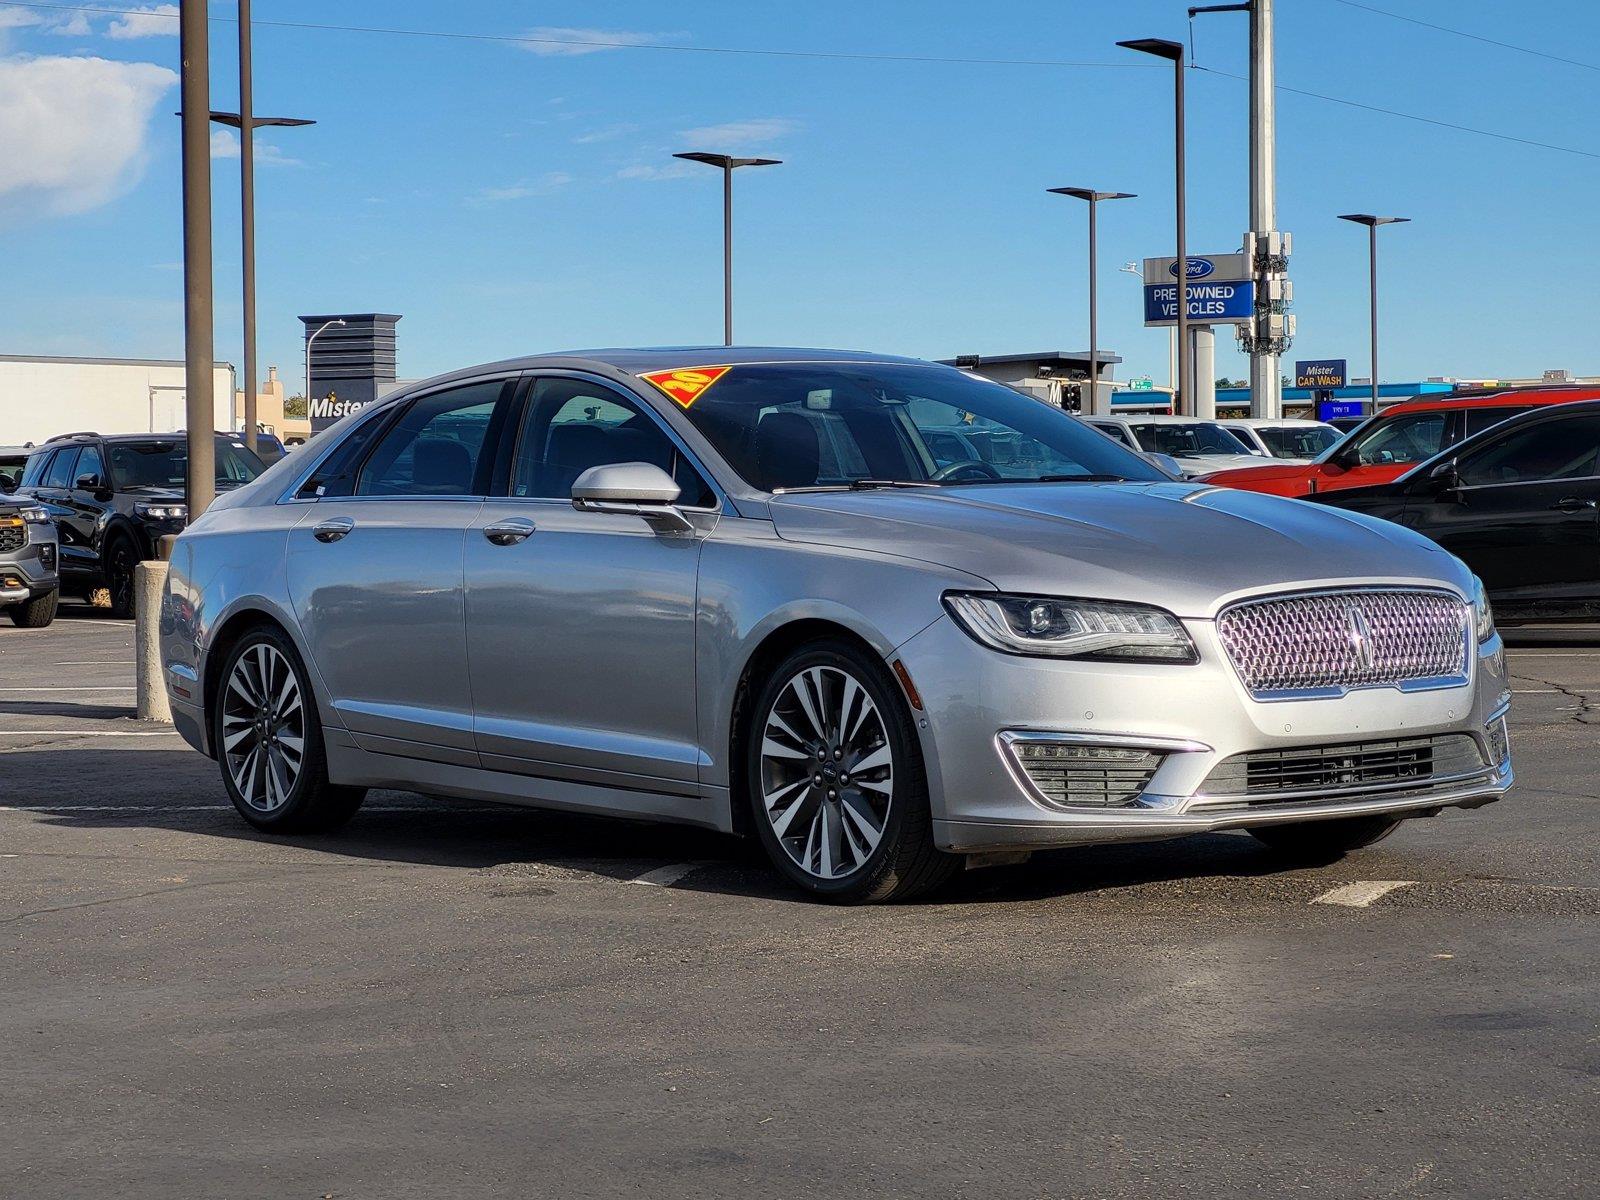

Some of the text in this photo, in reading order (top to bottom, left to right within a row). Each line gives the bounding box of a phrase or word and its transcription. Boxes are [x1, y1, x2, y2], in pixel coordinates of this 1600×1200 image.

[1161, 301, 1225, 316] VEICLES
[1306, 366, 1334, 375] Mister
[1298, 375, 1342, 386] CAR WASH
